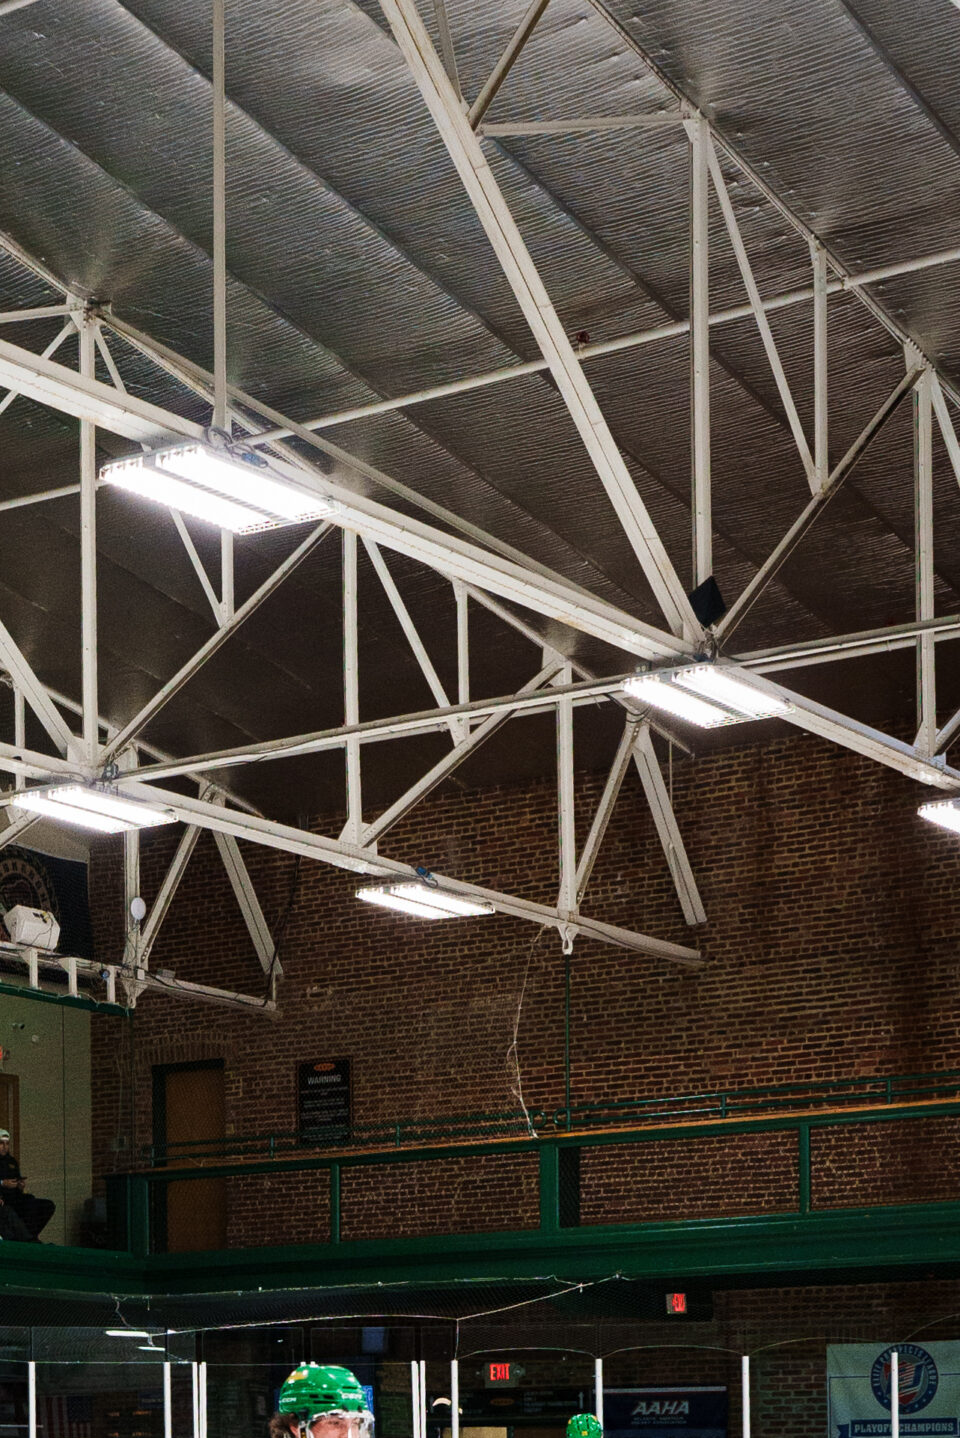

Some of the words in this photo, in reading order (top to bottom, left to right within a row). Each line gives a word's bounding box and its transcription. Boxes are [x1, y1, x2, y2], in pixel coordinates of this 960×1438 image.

[490, 1363, 510, 1380] EXIT
[632, 1401, 690, 1415] AAHA
[854, 1424, 892, 1433] PLAYOF
[899, 1422, 954, 1432] CHAMPIONS
